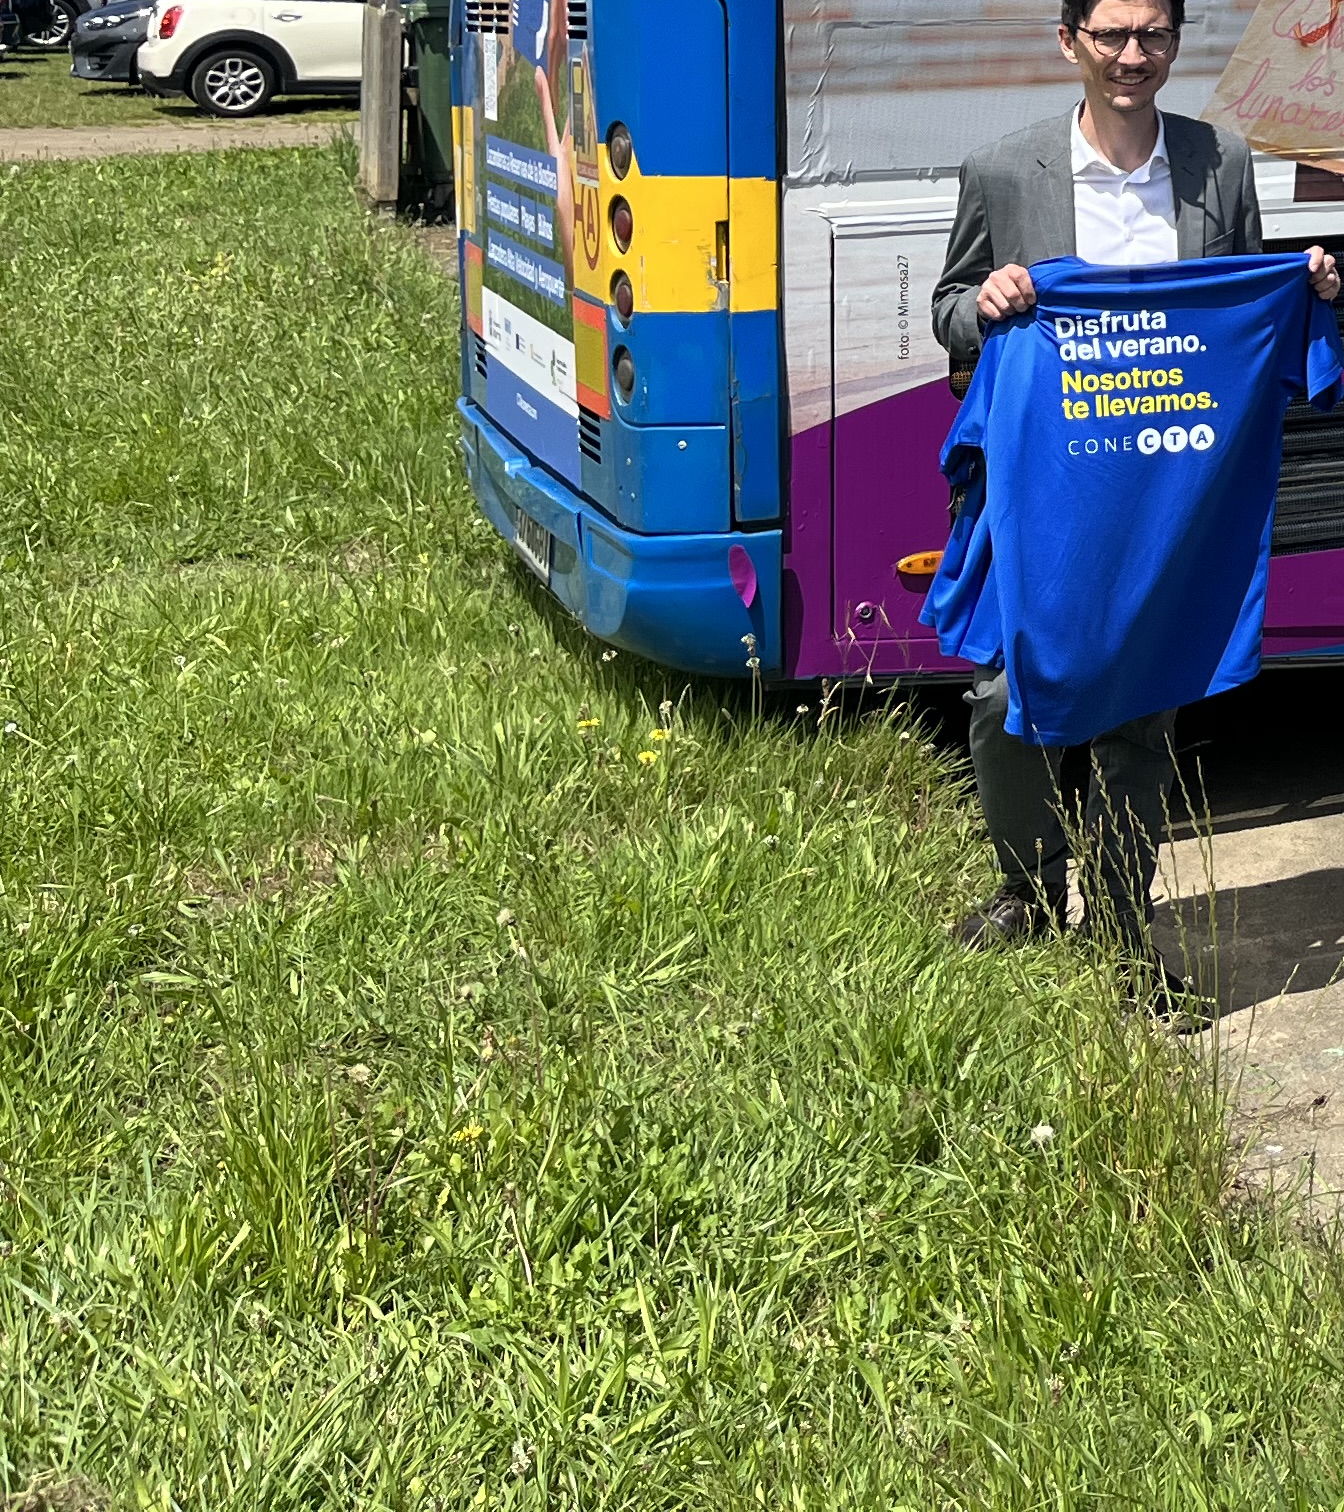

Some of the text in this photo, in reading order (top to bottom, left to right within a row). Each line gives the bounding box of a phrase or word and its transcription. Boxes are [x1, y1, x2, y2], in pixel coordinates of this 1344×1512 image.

[1290, 54, 1337, 97] los
[897, 255, 908, 317] Mimosa27
[1055, 310, 1166, 339] Disfruta
[897, 331, 909, 360] foto:
[1059, 334, 1207, 361] del verano.
[1061, 367, 1183, 394] Nosotros
[1062, 391, 1218, 420] te llevamos.
[1068, 424, 1215, 455] CONECTA
